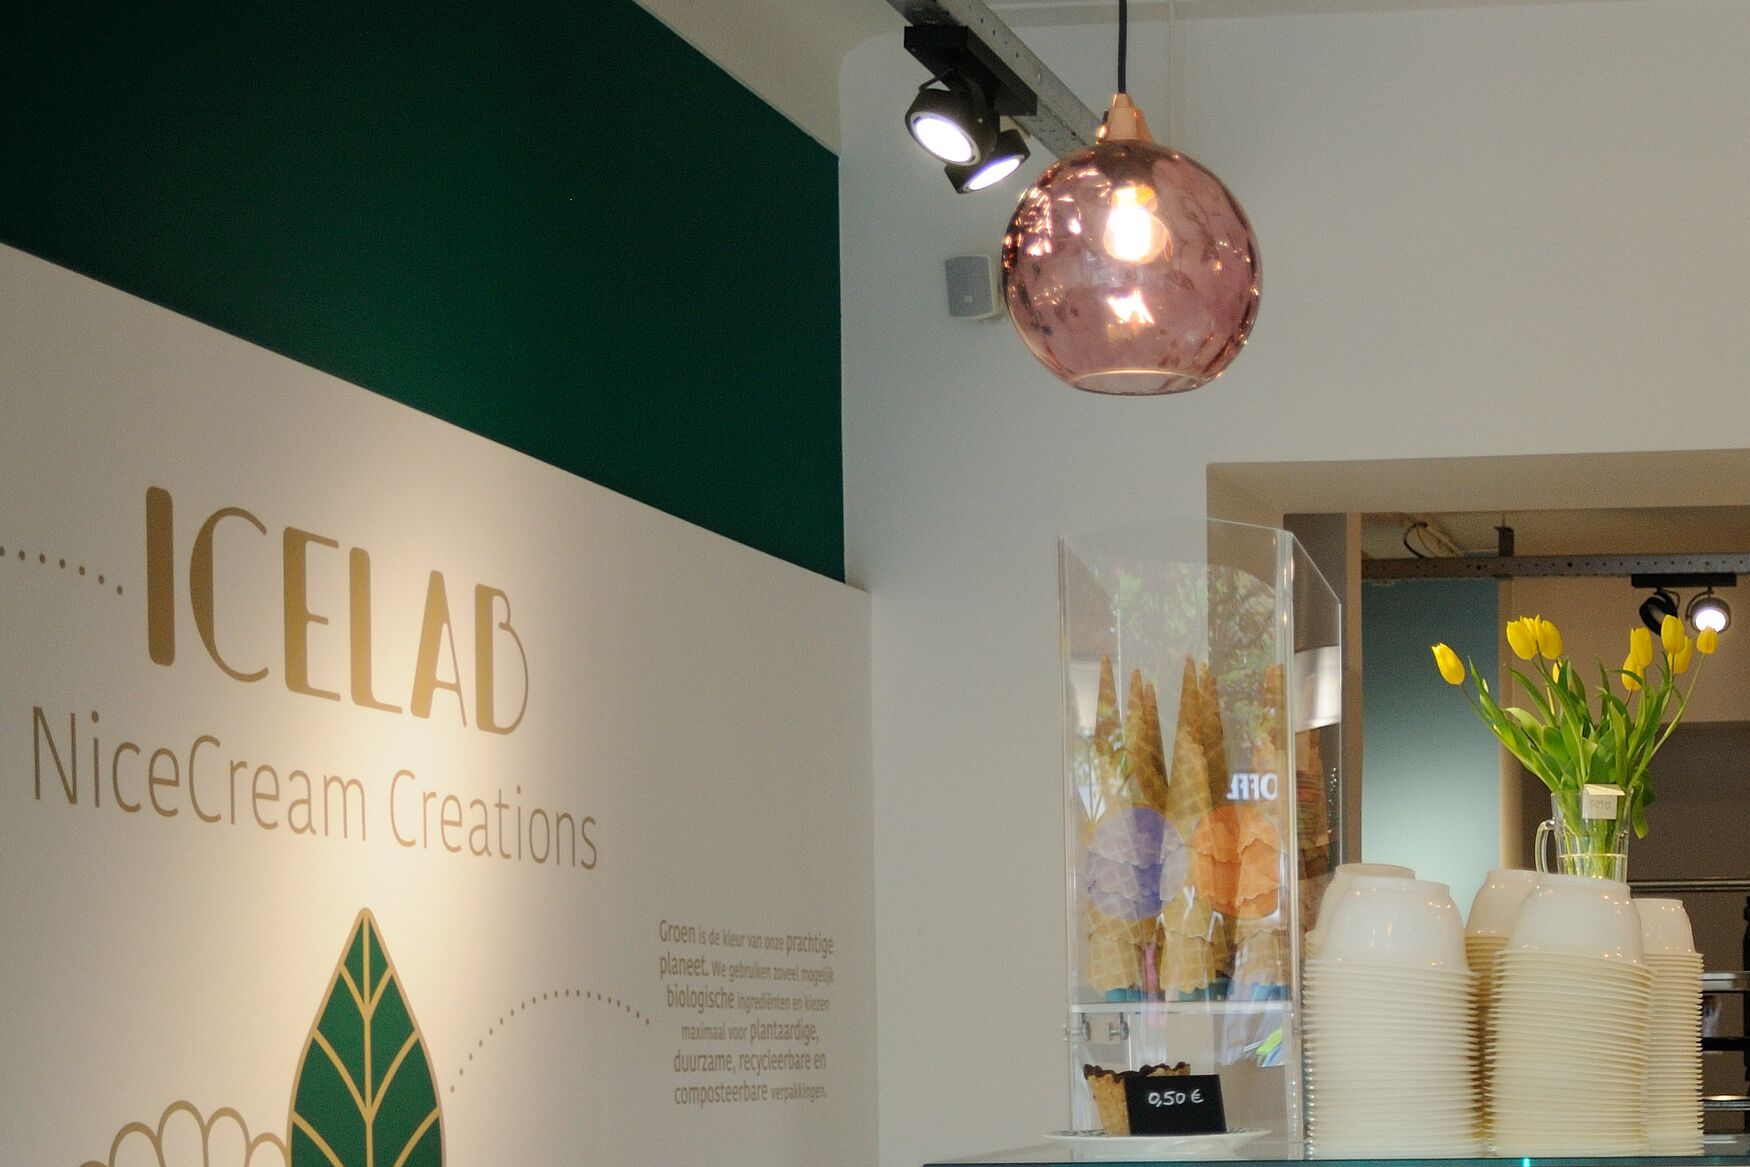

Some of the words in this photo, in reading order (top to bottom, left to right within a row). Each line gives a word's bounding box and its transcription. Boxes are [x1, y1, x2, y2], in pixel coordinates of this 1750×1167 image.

[145, 485, 529, 735] ICELAB
[33, 705, 367, 841] NiceCream
[389, 768, 598, 870] Creations
[659, 919, 696, 943] Groen
[699, 926, 706, 945] is
[709, 928, 720, 946] de
[722, 928, 744, 947] kleur
[747, 935, 762, 948] van
[786, 932, 834, 959] prachtige
[660, 950, 709, 980] planeet.
[712, 960, 726, 978] We
[667, 982, 735, 1014] biologische
[728, 1026, 748, 1040] voor
[750, 1017, 819, 1046] plantaardige,
[674, 1049, 736, 1075] duurzame,
[739, 1048, 811, 1076] recycleerbare
[814, 1053, 826, 1070] en
[674, 1080, 768, 1109] composteerbare
[1148, 1090, 1186, 1108] 0,50
[1191, 1088, 1204, 1103] €
